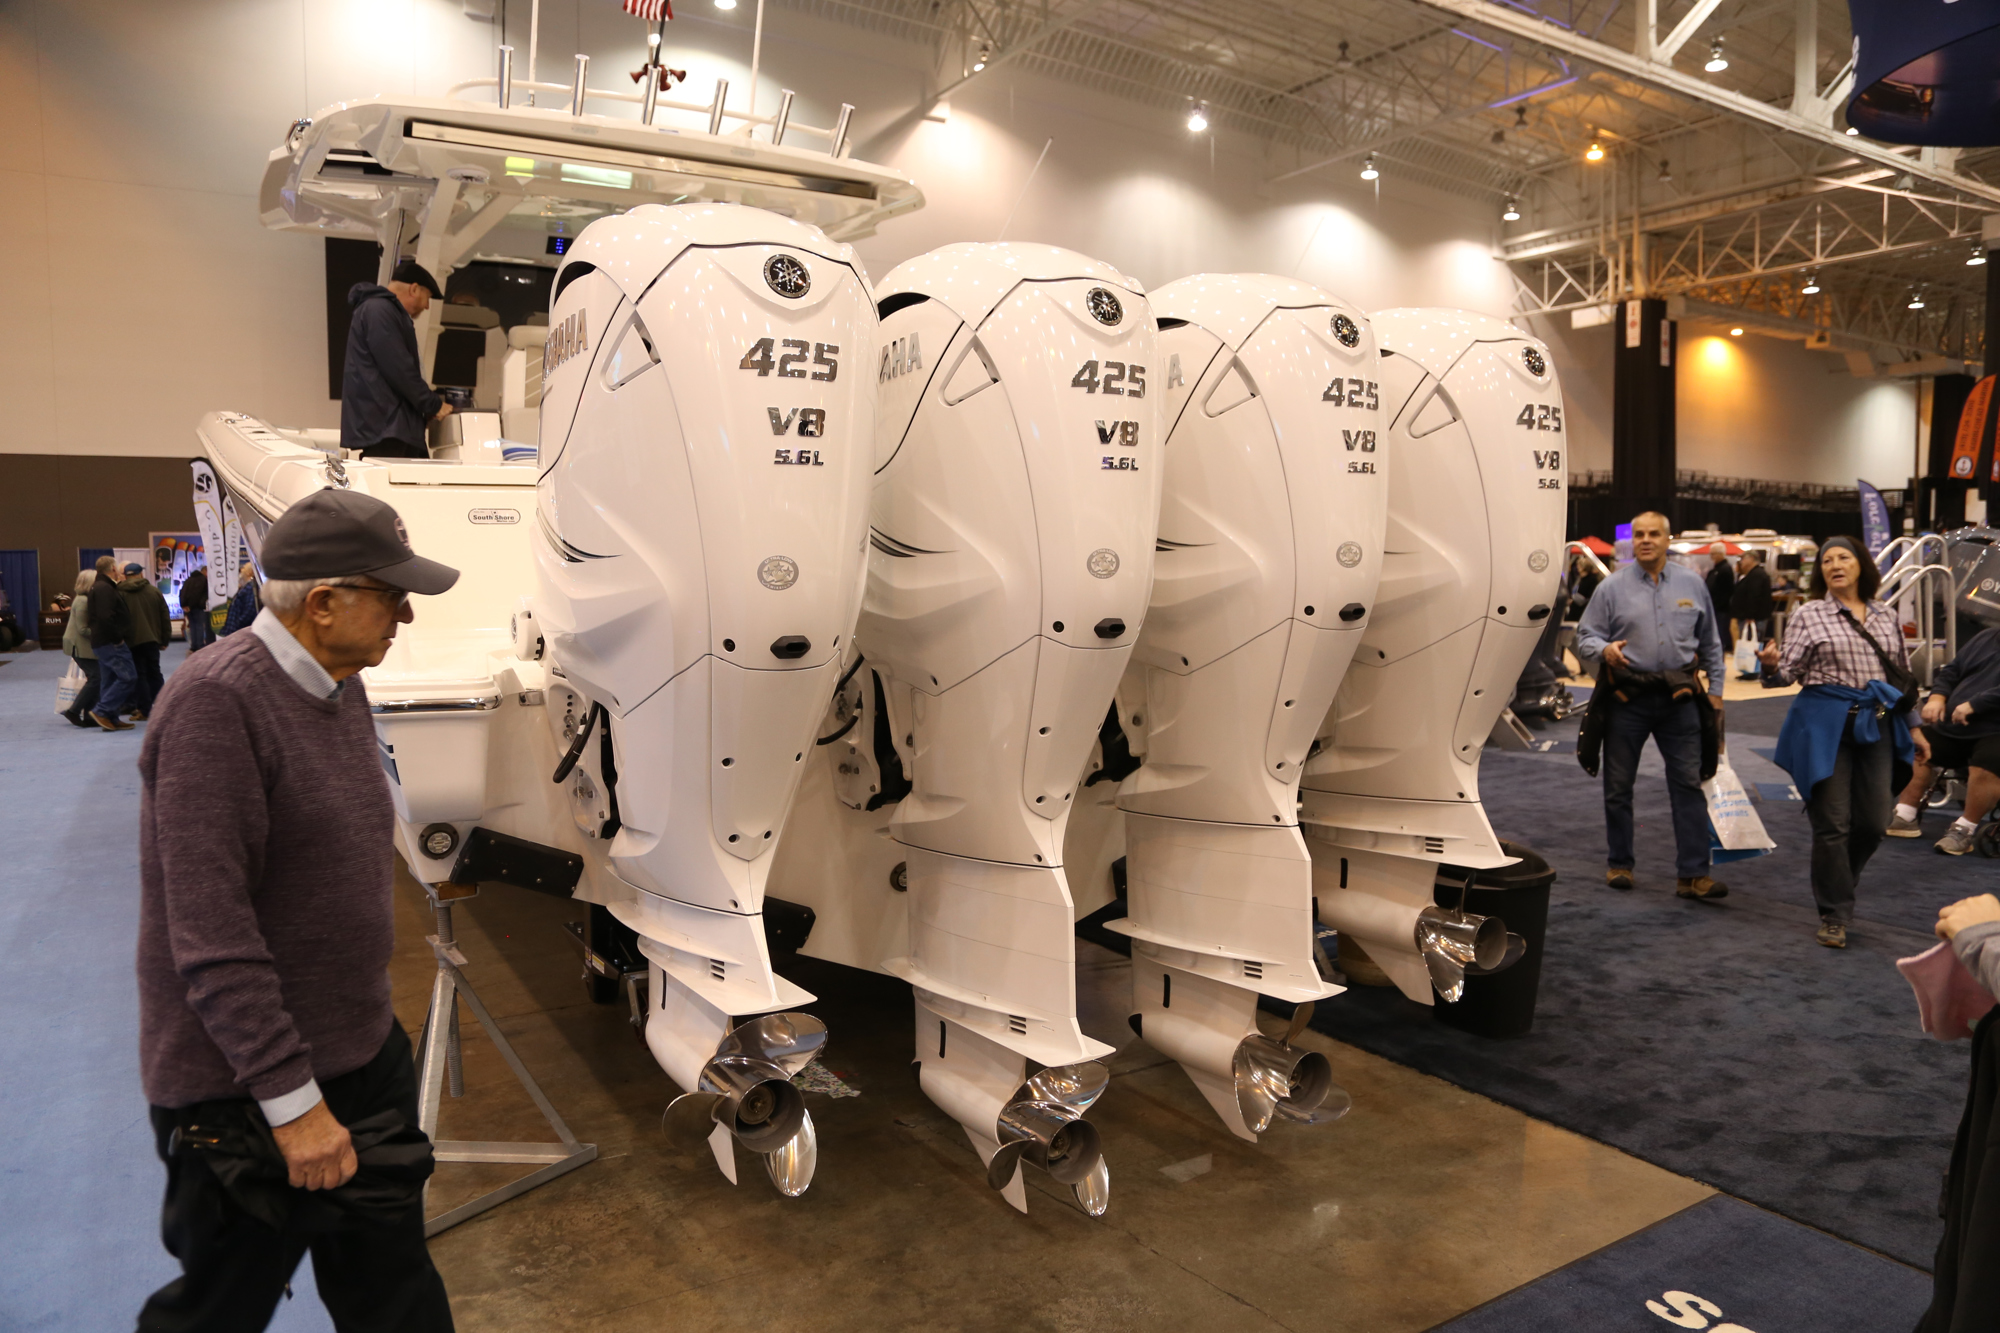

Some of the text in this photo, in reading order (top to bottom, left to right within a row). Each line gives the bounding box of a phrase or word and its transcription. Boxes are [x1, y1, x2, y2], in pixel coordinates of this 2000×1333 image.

[739, 337, 839, 382] 425
[879, 332, 922, 384] AHA
[1071, 360, 1146, 398] 425
[1321, 377, 1379, 411] 425
[767, 407, 826, 437] V8
[1516, 403, 1561, 432] 425
[1095, 420, 1139, 446] V8
[1342, 430, 1376, 453] V8
[774, 449, 824, 466] 5.6L
[1101, 456, 1139, 471] 5.6L
[1347, 461, 1376, 474] 5.6L
[1533, 450, 1560, 470] V8
[1538, 478, 1561, 489] 5.6L
